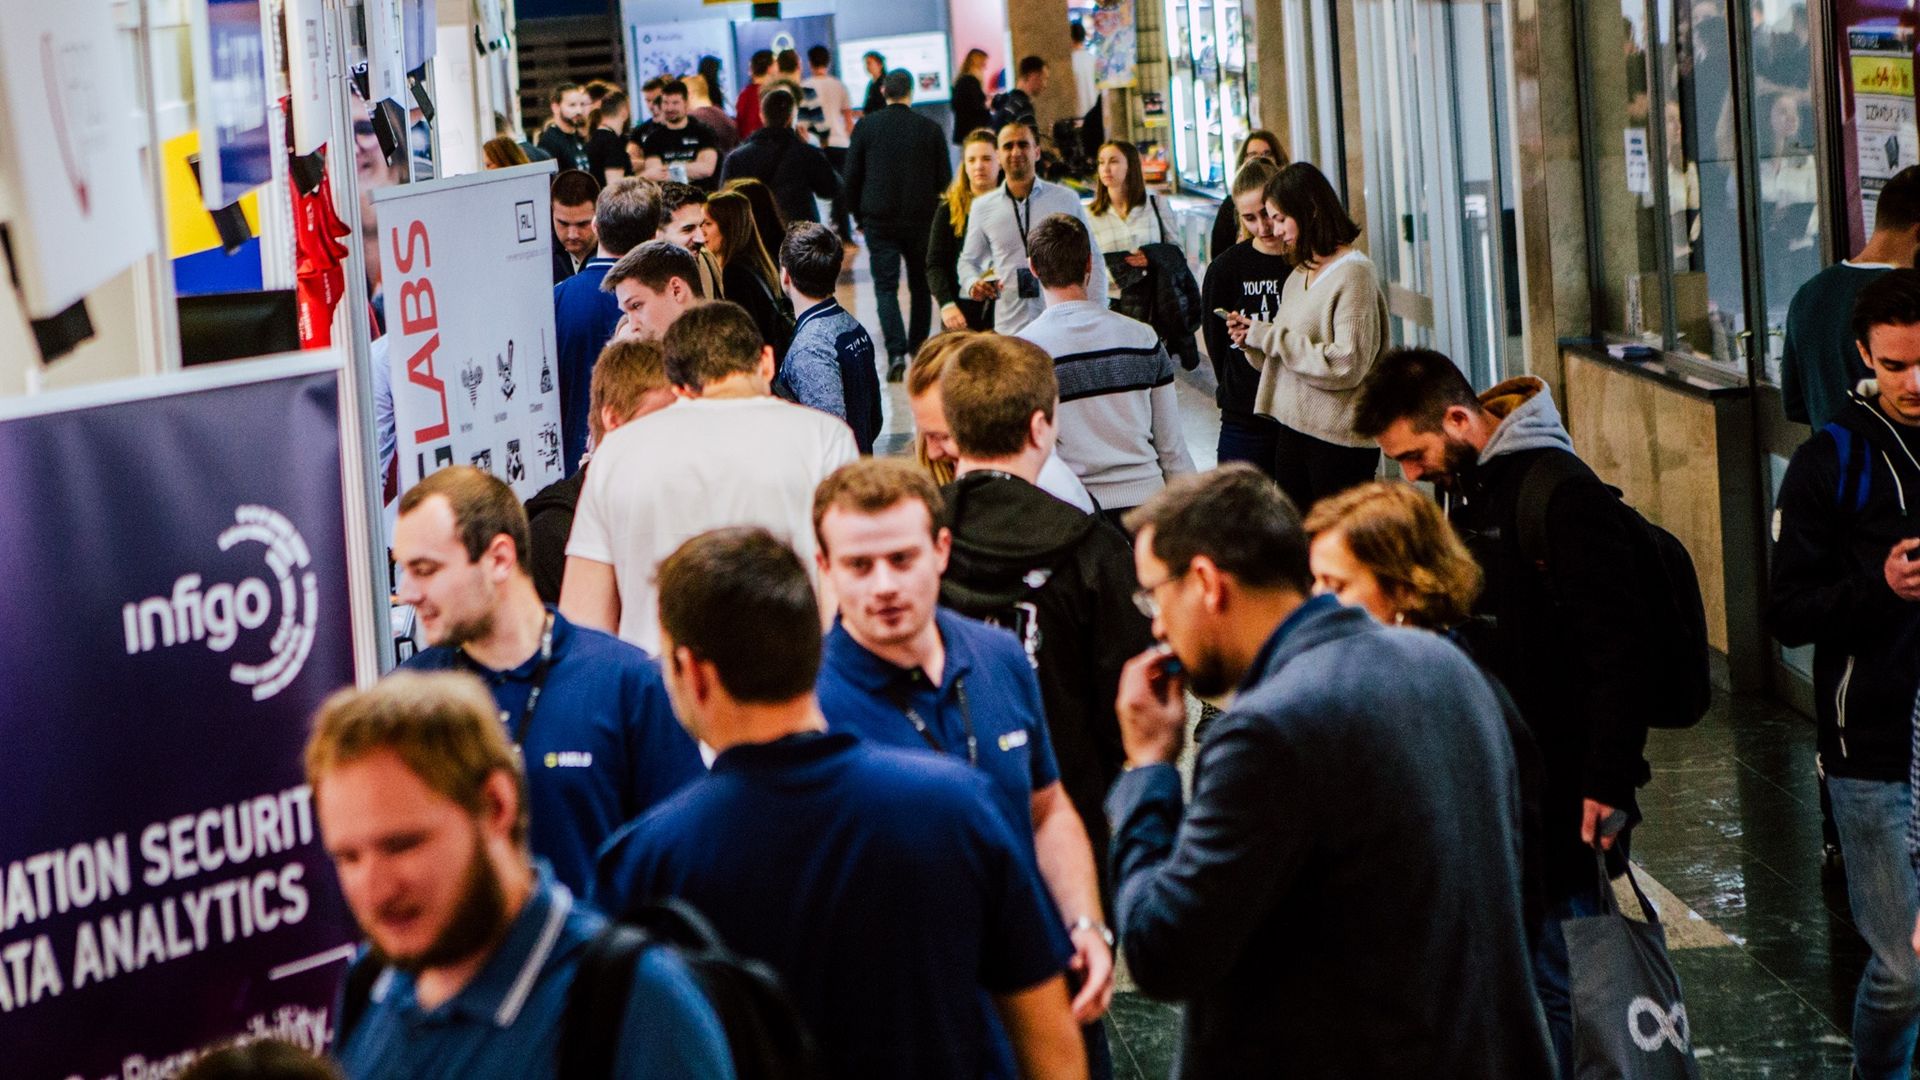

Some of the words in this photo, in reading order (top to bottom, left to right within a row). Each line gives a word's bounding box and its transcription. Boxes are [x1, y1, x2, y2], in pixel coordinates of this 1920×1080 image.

[1243, 280, 1279, 295] YOU'RE
[1261, 294, 1268, 311] A
[122, 572, 272, 655] infigo
[0, 831, 131, 932] ATION
[140, 784, 313, 886] SECURIT
[73, 862, 309, 989] ANALYTICS
